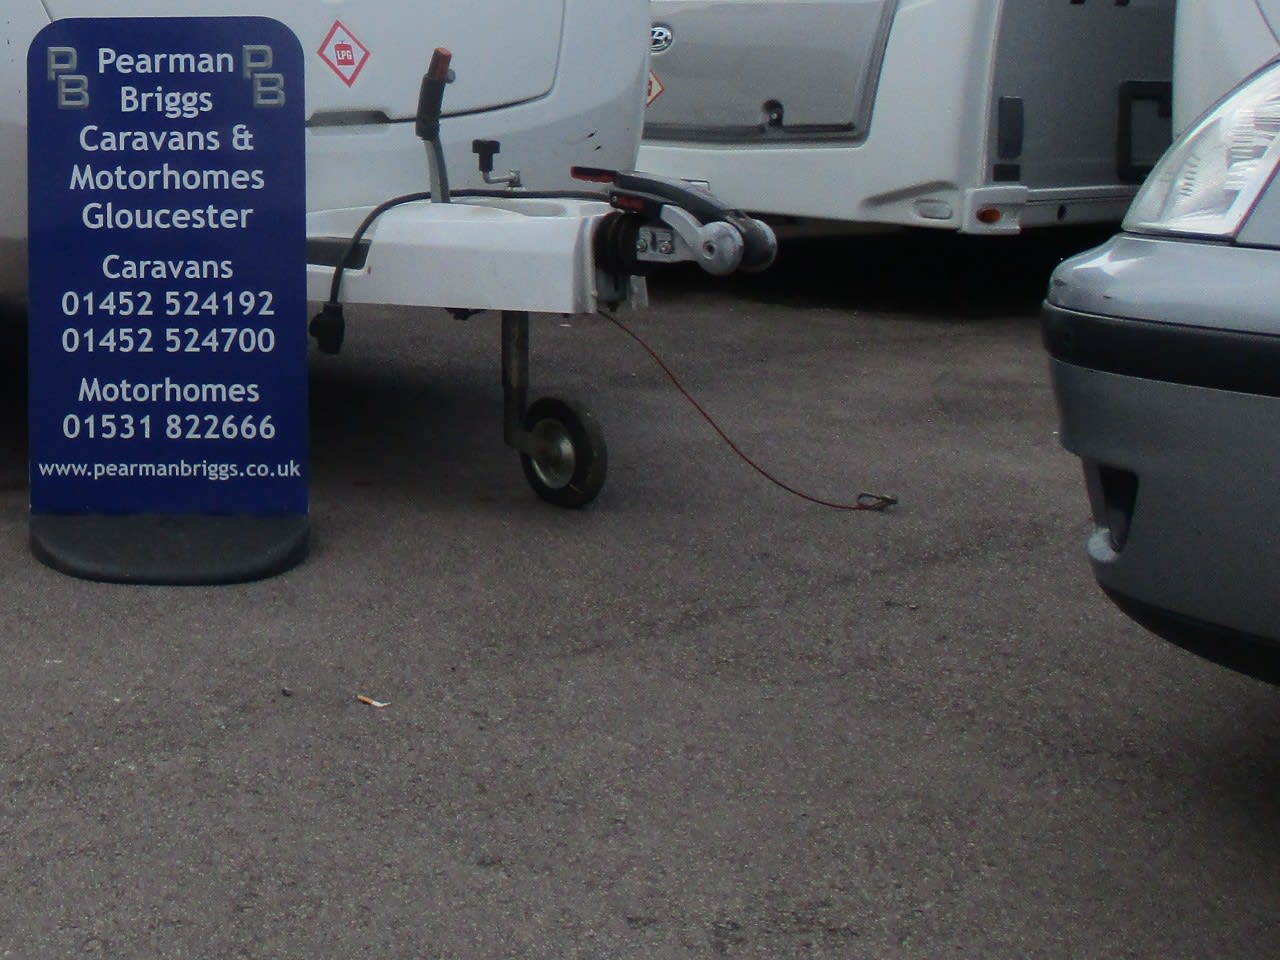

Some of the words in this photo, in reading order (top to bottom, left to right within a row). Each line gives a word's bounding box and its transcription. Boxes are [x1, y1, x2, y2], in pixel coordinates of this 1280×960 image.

[97, 47, 234, 73] Pearman
[336, 49, 353, 61] LPG
[120, 86, 213, 118] Briggs
[79, 125, 220, 151] Caravans
[231, 124, 254, 151] &
[69, 163, 265, 190] Motorhomes
[81, 202, 254, 229] Gloucester
[102, 254, 234, 280] Caravans
[61, 291, 154, 316] 01452
[165, 291, 275, 316] 524192
[61, 328, 154, 353] 01452
[165, 328, 276, 353] 524700
[78, 377, 260, 403] Motorhomes
[62, 414, 152, 439] 01531
[165, 414, 276, 440] 822666
[38, 460, 302, 481] www.pearmanbriggs.co.uk
